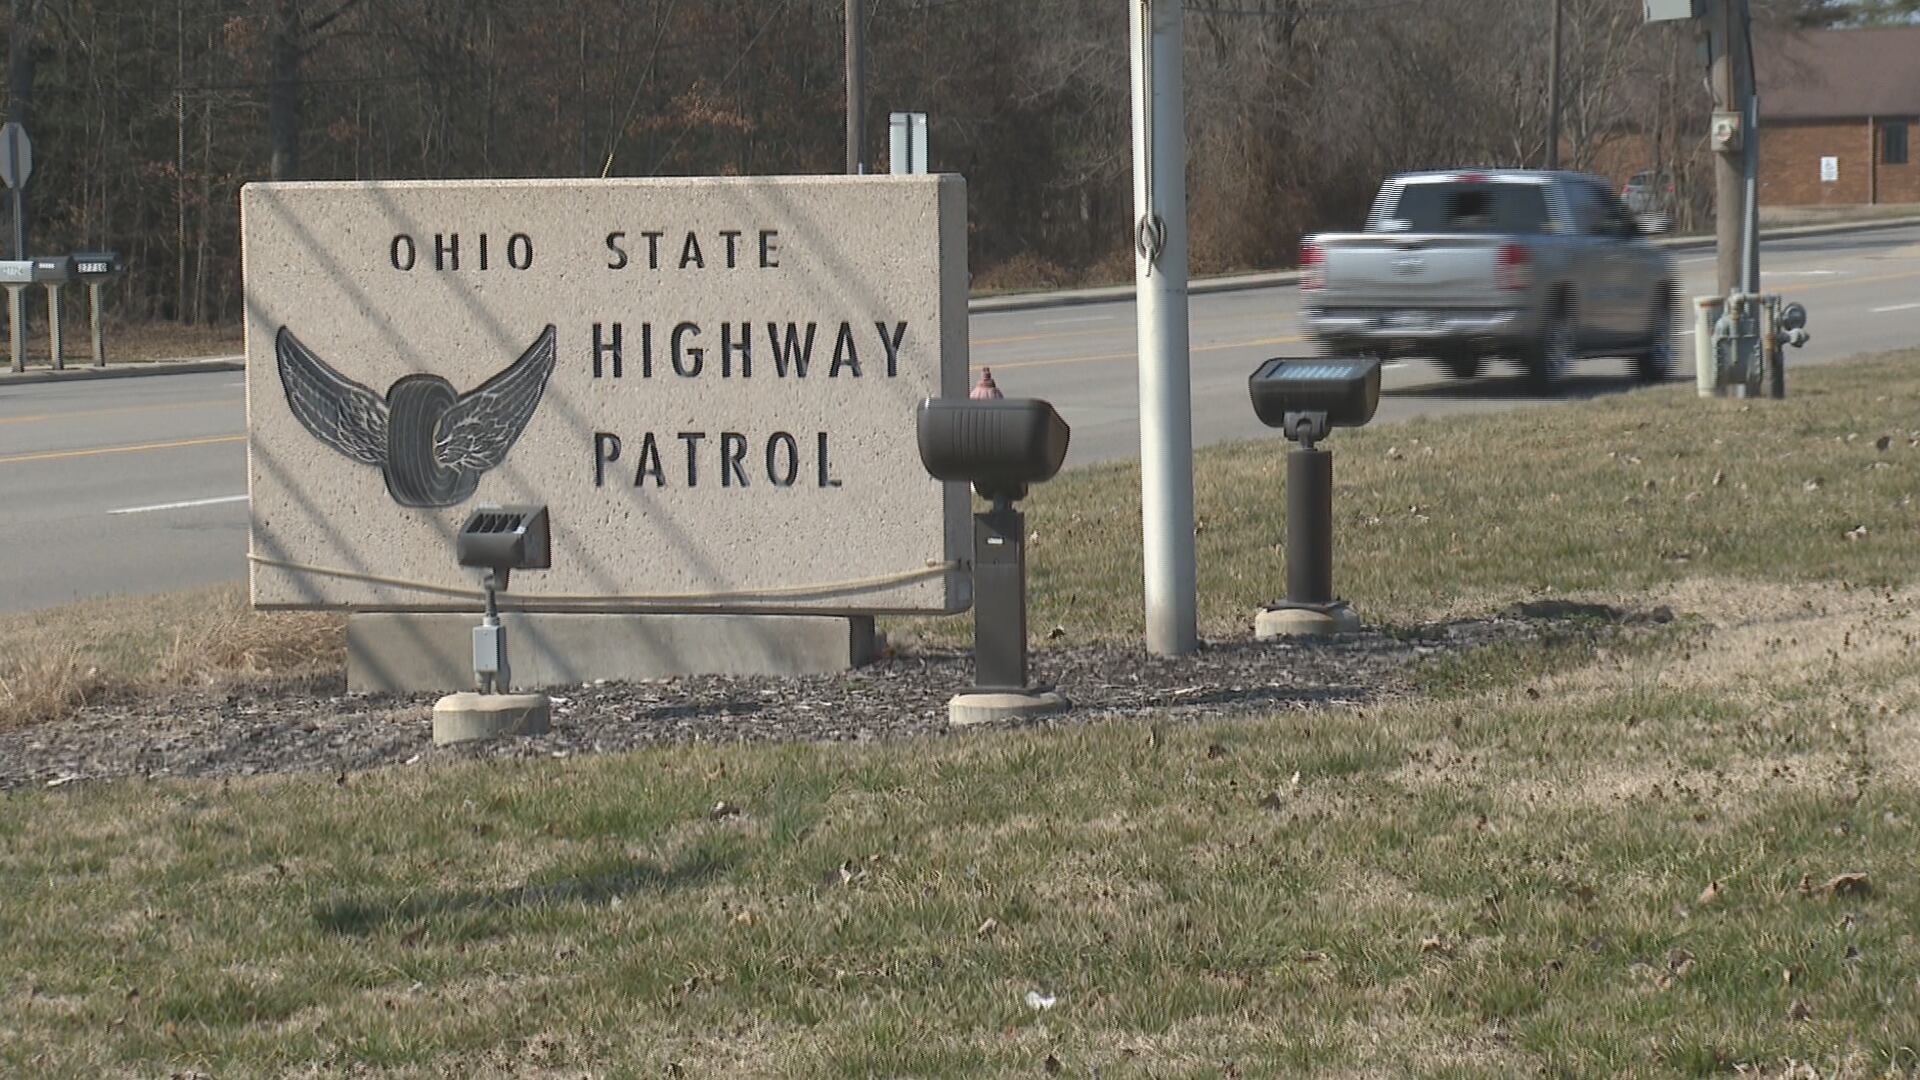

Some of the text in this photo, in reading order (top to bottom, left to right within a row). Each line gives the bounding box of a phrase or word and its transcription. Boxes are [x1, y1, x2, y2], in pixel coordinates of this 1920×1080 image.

[391, 230, 779, 271] OHIO STATE
[593, 321, 908, 378] HIGHWAY
[595, 431, 843, 488] PATROL
